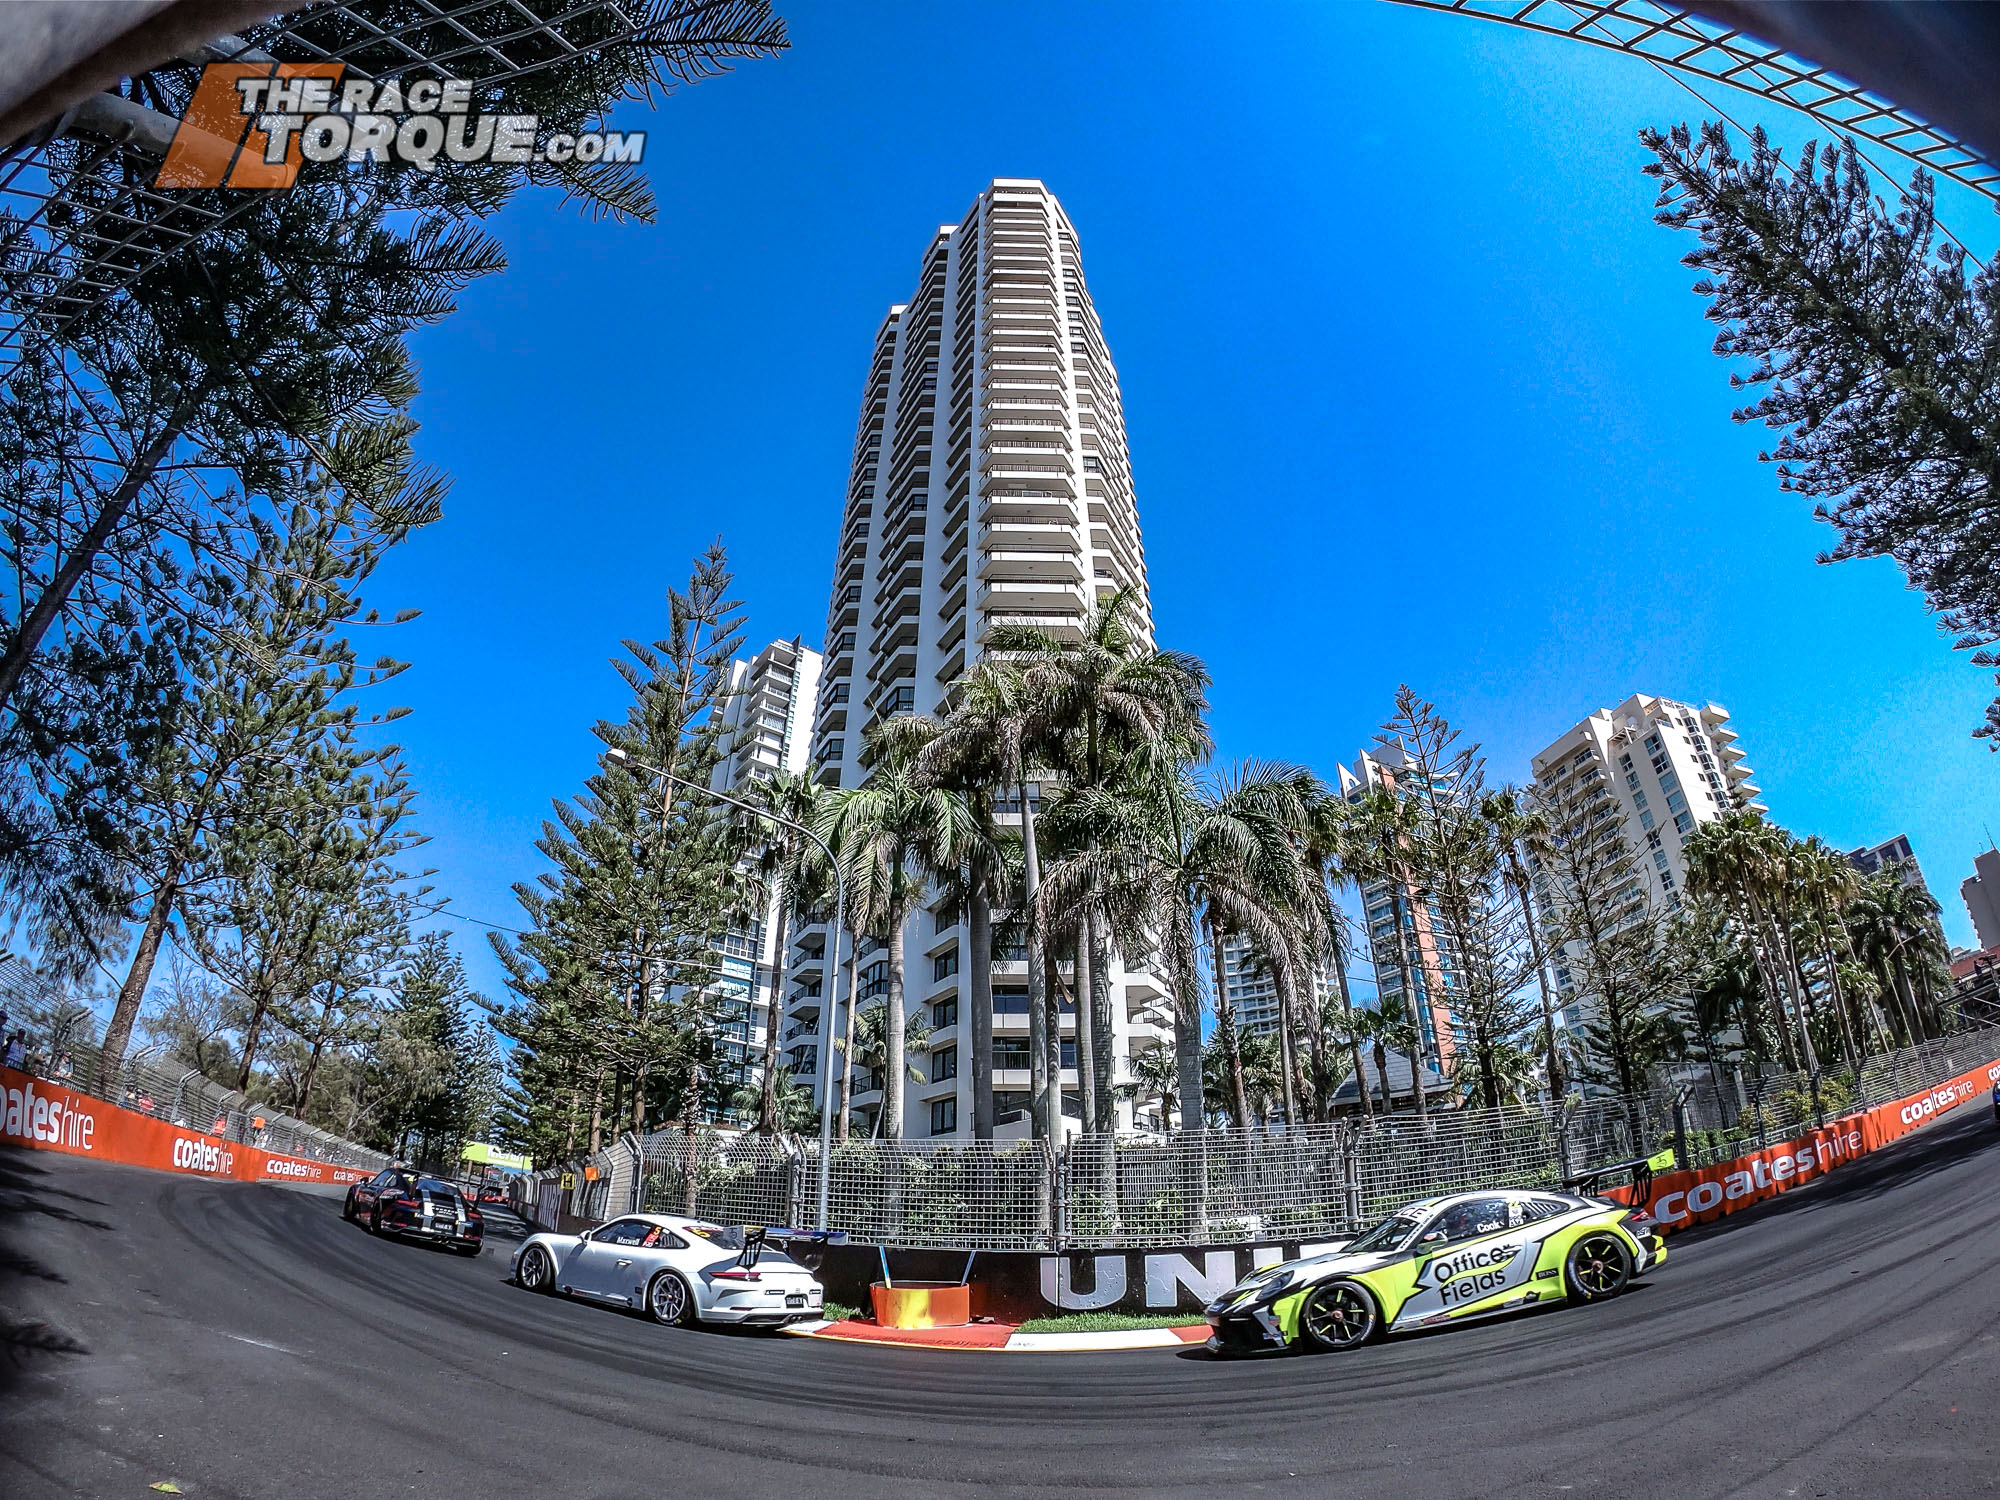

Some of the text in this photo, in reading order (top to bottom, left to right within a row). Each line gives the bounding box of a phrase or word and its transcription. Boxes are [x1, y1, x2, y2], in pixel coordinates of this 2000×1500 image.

[1477, 1220, 1501, 1234] Cook
[1434, 1247, 1504, 1283] Office
[1439, 1269, 1506, 1306] Fields
